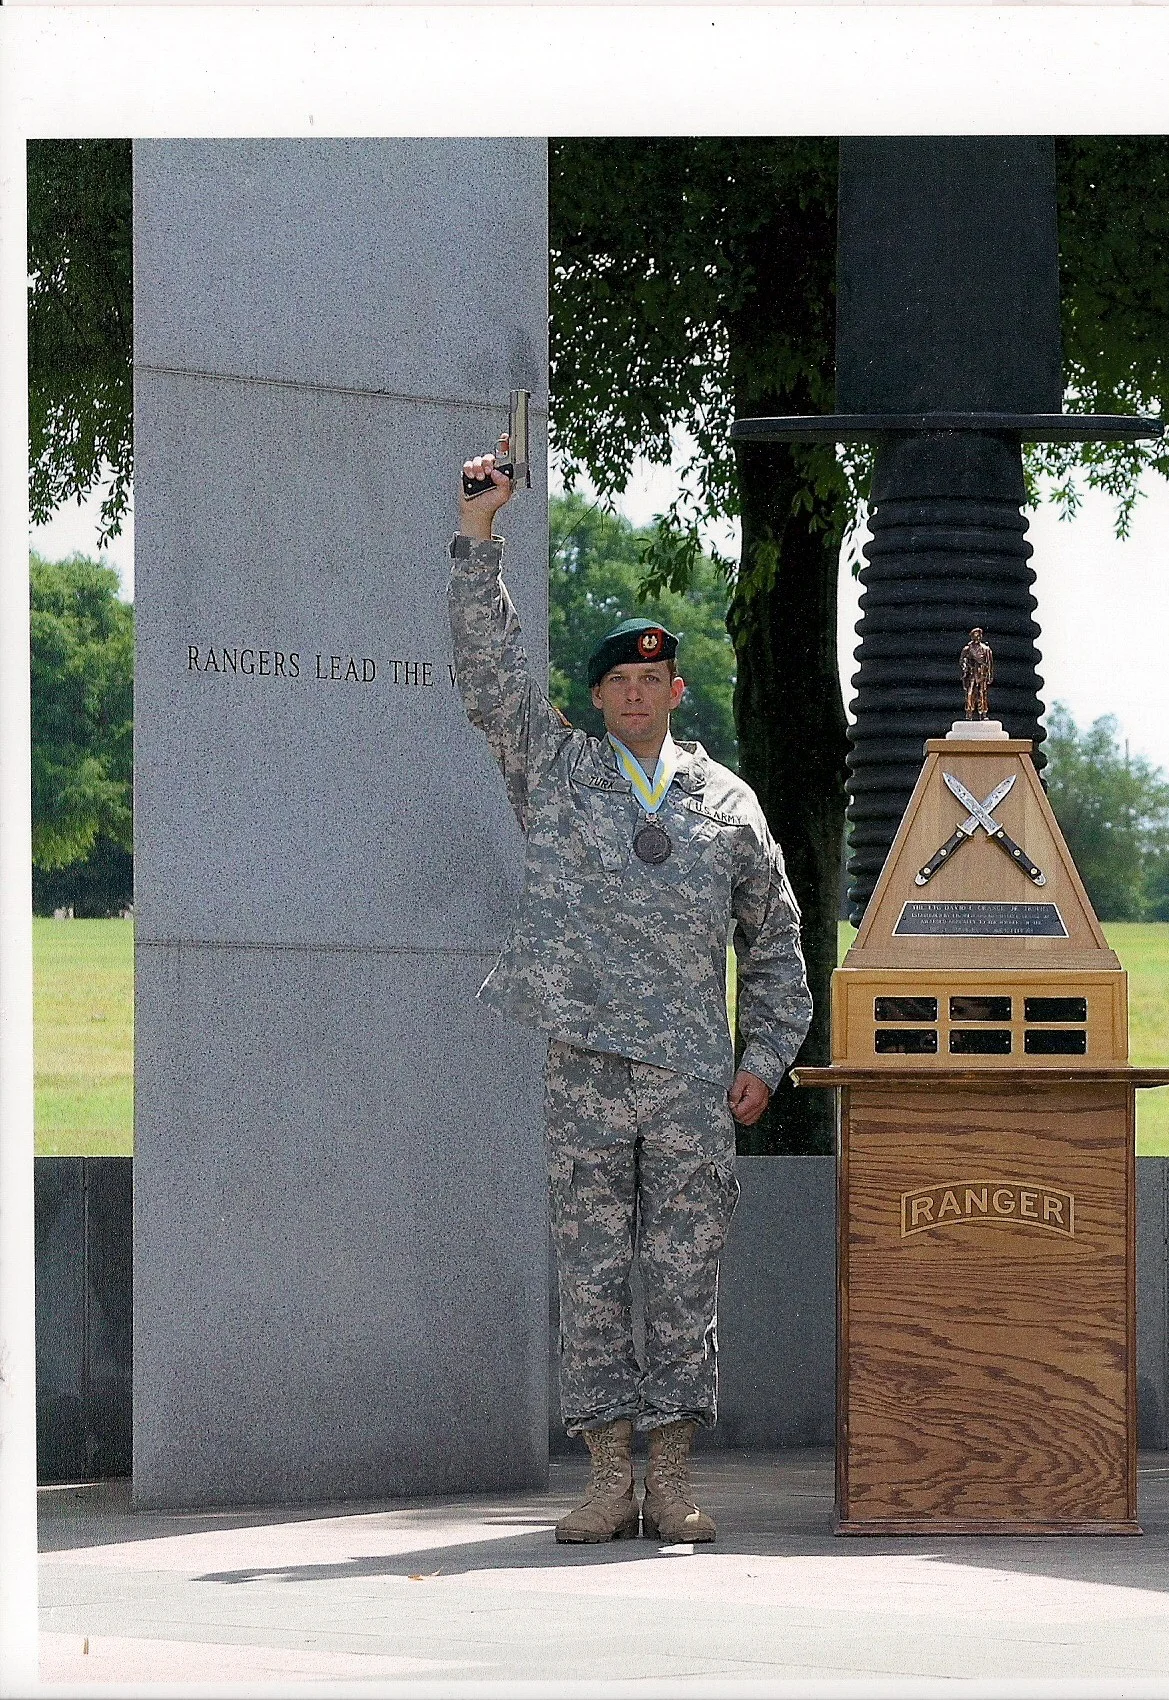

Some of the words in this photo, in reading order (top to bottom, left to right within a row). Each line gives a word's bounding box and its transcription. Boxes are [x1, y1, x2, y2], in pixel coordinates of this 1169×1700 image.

[188, 645, 300, 678] RANGERS
[315, 654, 376, 683] LEAD
[388, 660, 434, 687] THE
[588, 775, 616, 790] TURK
[695, 801, 711, 815] U.S.
[713, 811, 742, 825] ARMY
[910, 1187, 1064, 1227] RANGER
